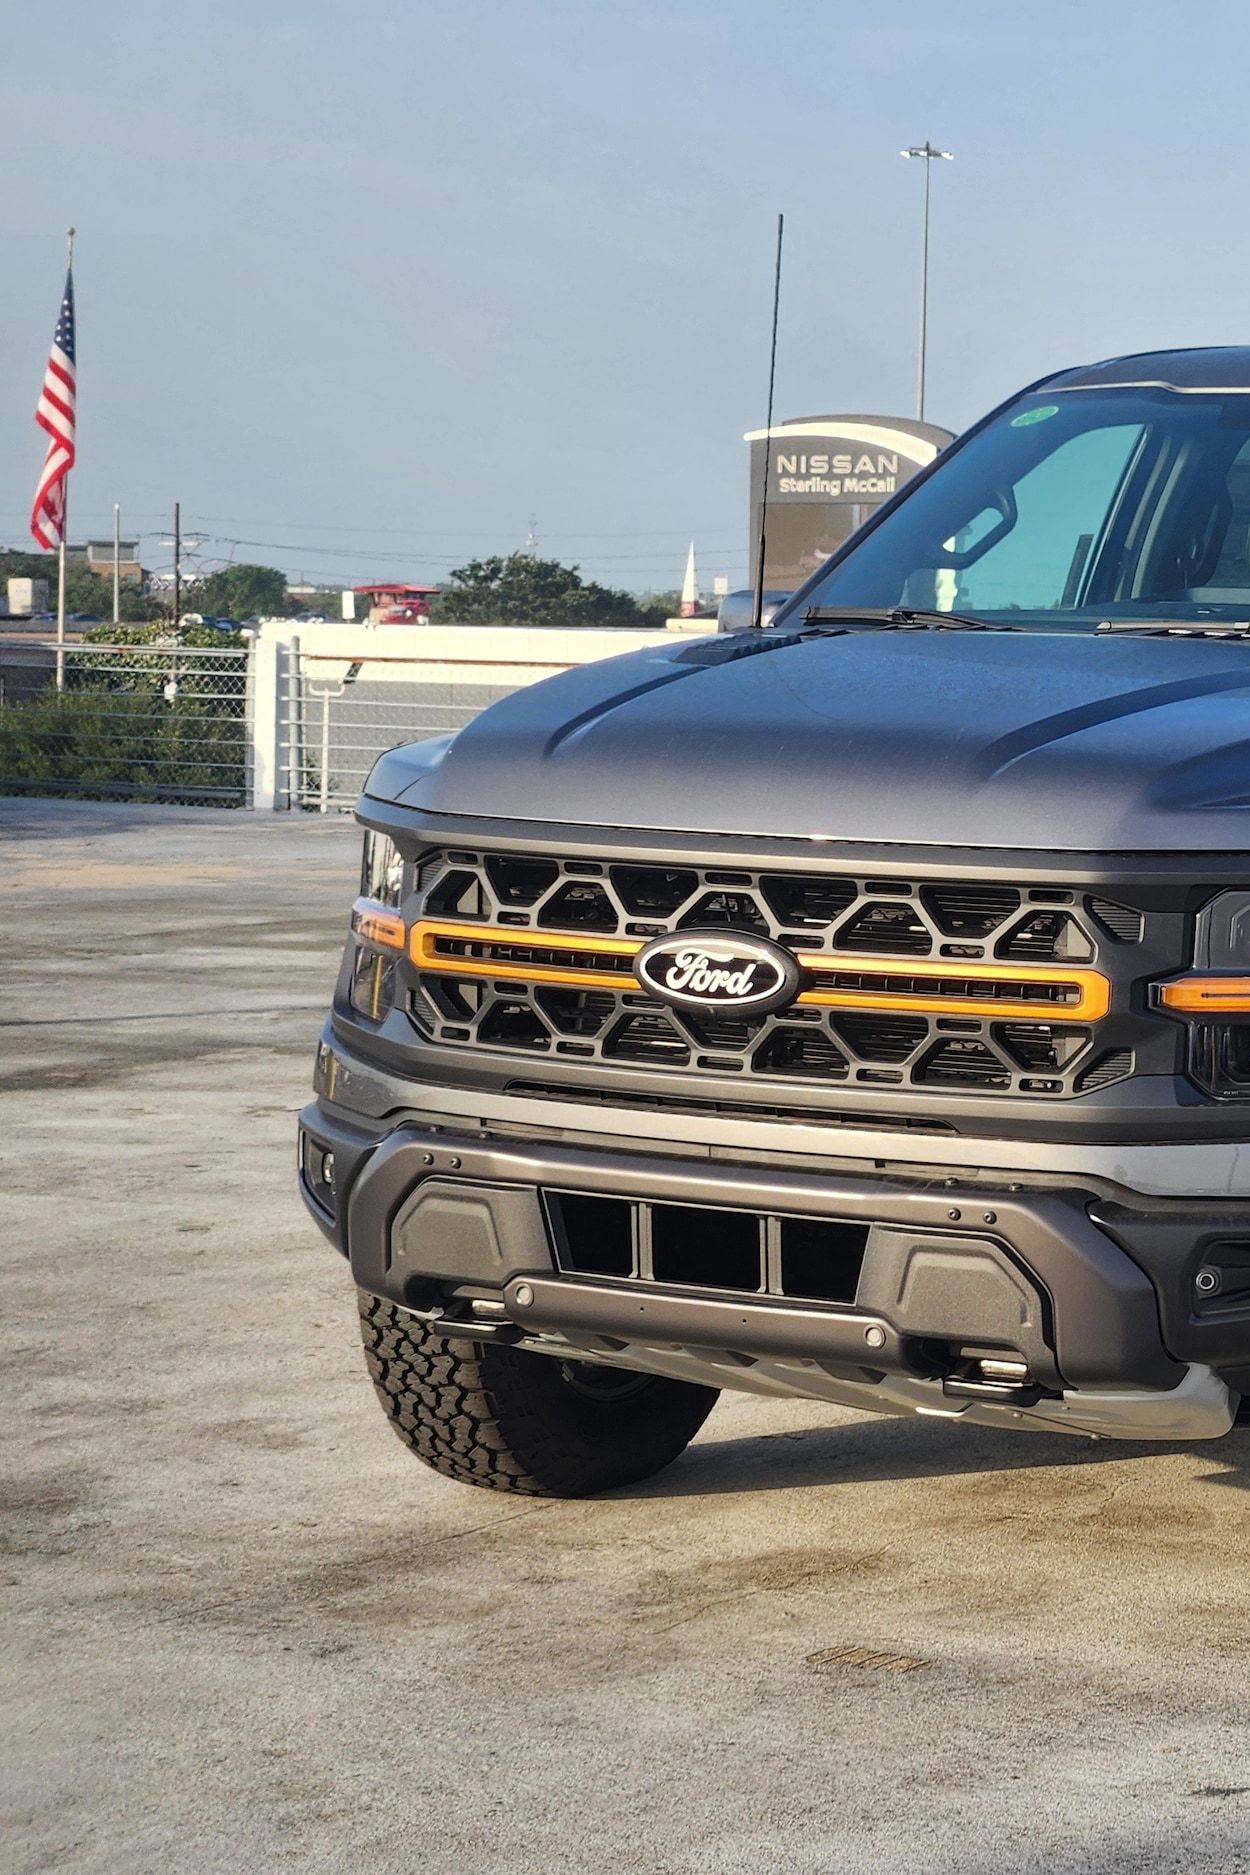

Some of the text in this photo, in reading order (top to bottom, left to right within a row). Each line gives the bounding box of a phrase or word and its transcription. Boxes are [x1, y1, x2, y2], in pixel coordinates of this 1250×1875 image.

[776, 454, 899, 474] NISSAN
[779, 477, 896, 496] Sterling McCall
[665, 948, 756, 995] Ford
